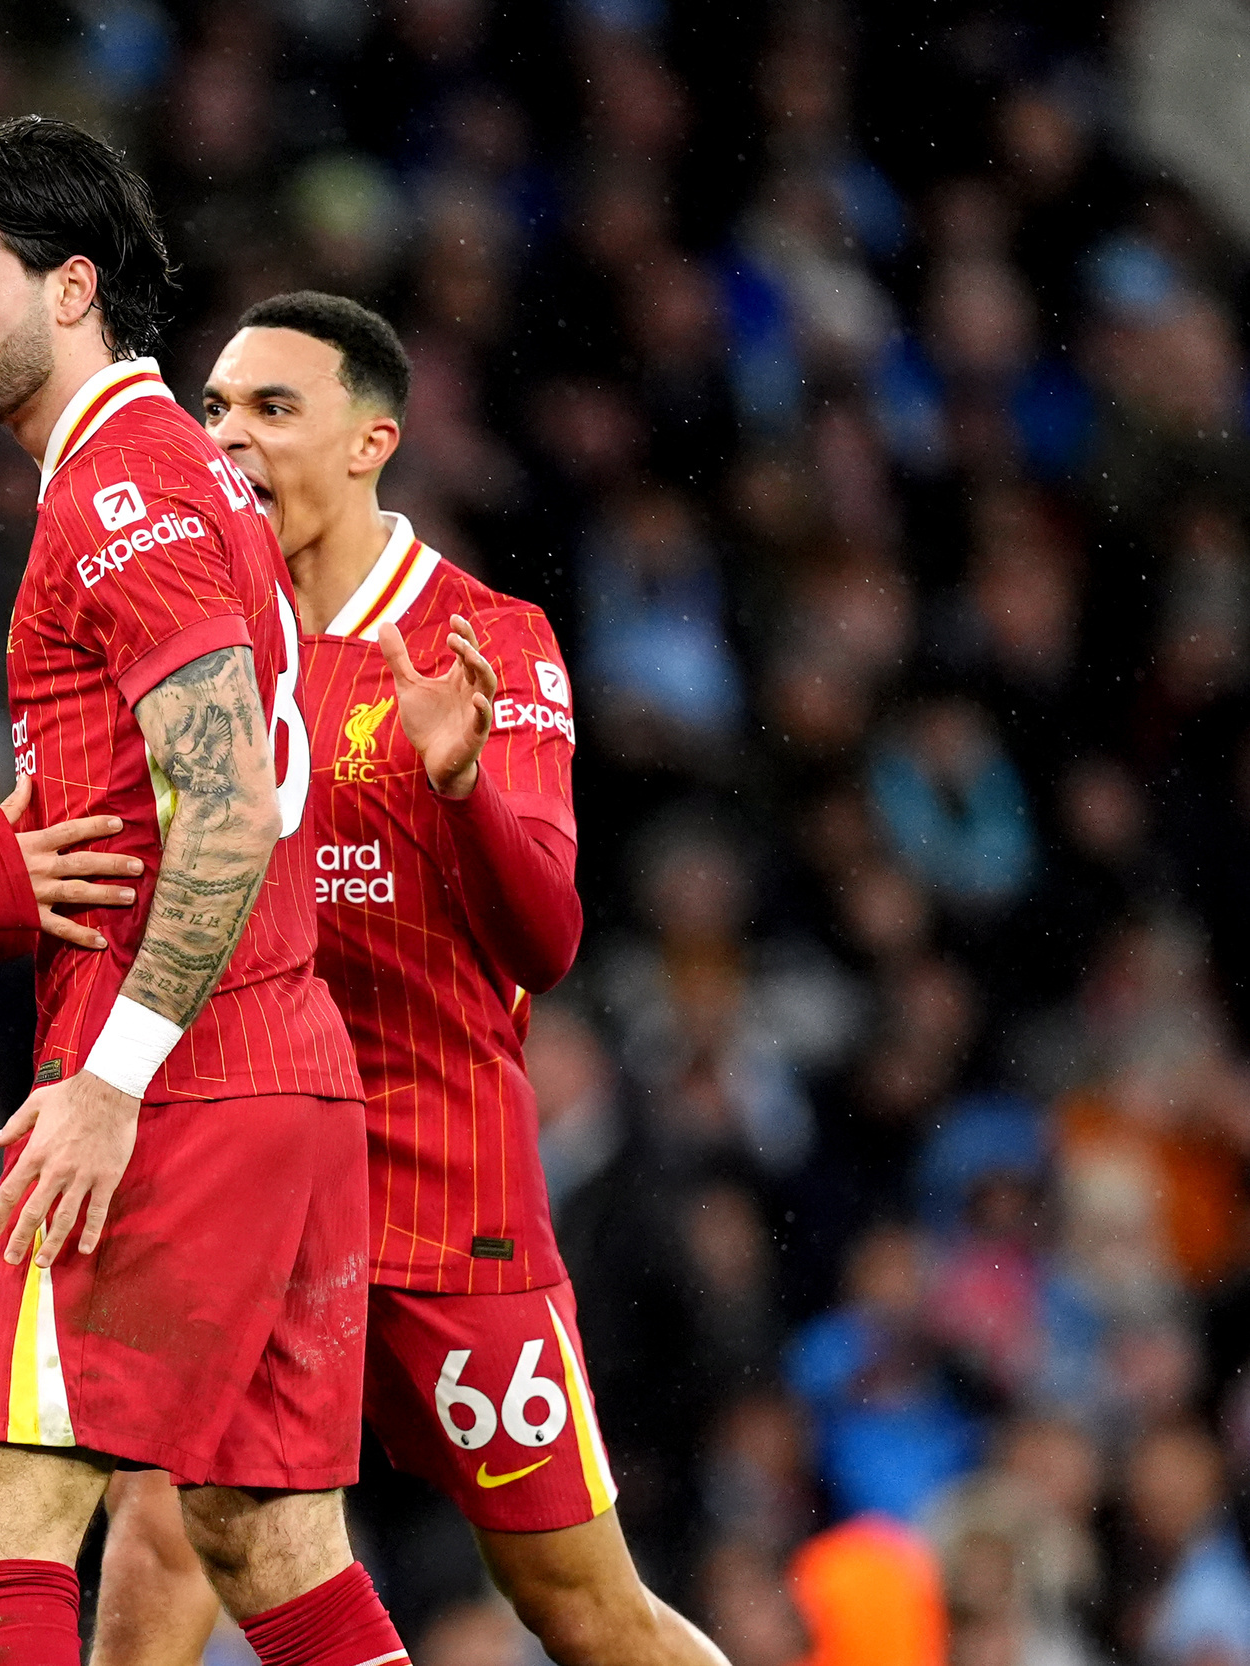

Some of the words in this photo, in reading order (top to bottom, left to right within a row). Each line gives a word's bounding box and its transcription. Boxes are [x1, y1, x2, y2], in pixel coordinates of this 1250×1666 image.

[77, 512, 207, 589] Expedia
[494, 698, 576, 746] Exped
[334, 762, 378, 784] L.F.C.
[316, 838, 381, 871] ard
[434, 1338, 568, 1451] 66
